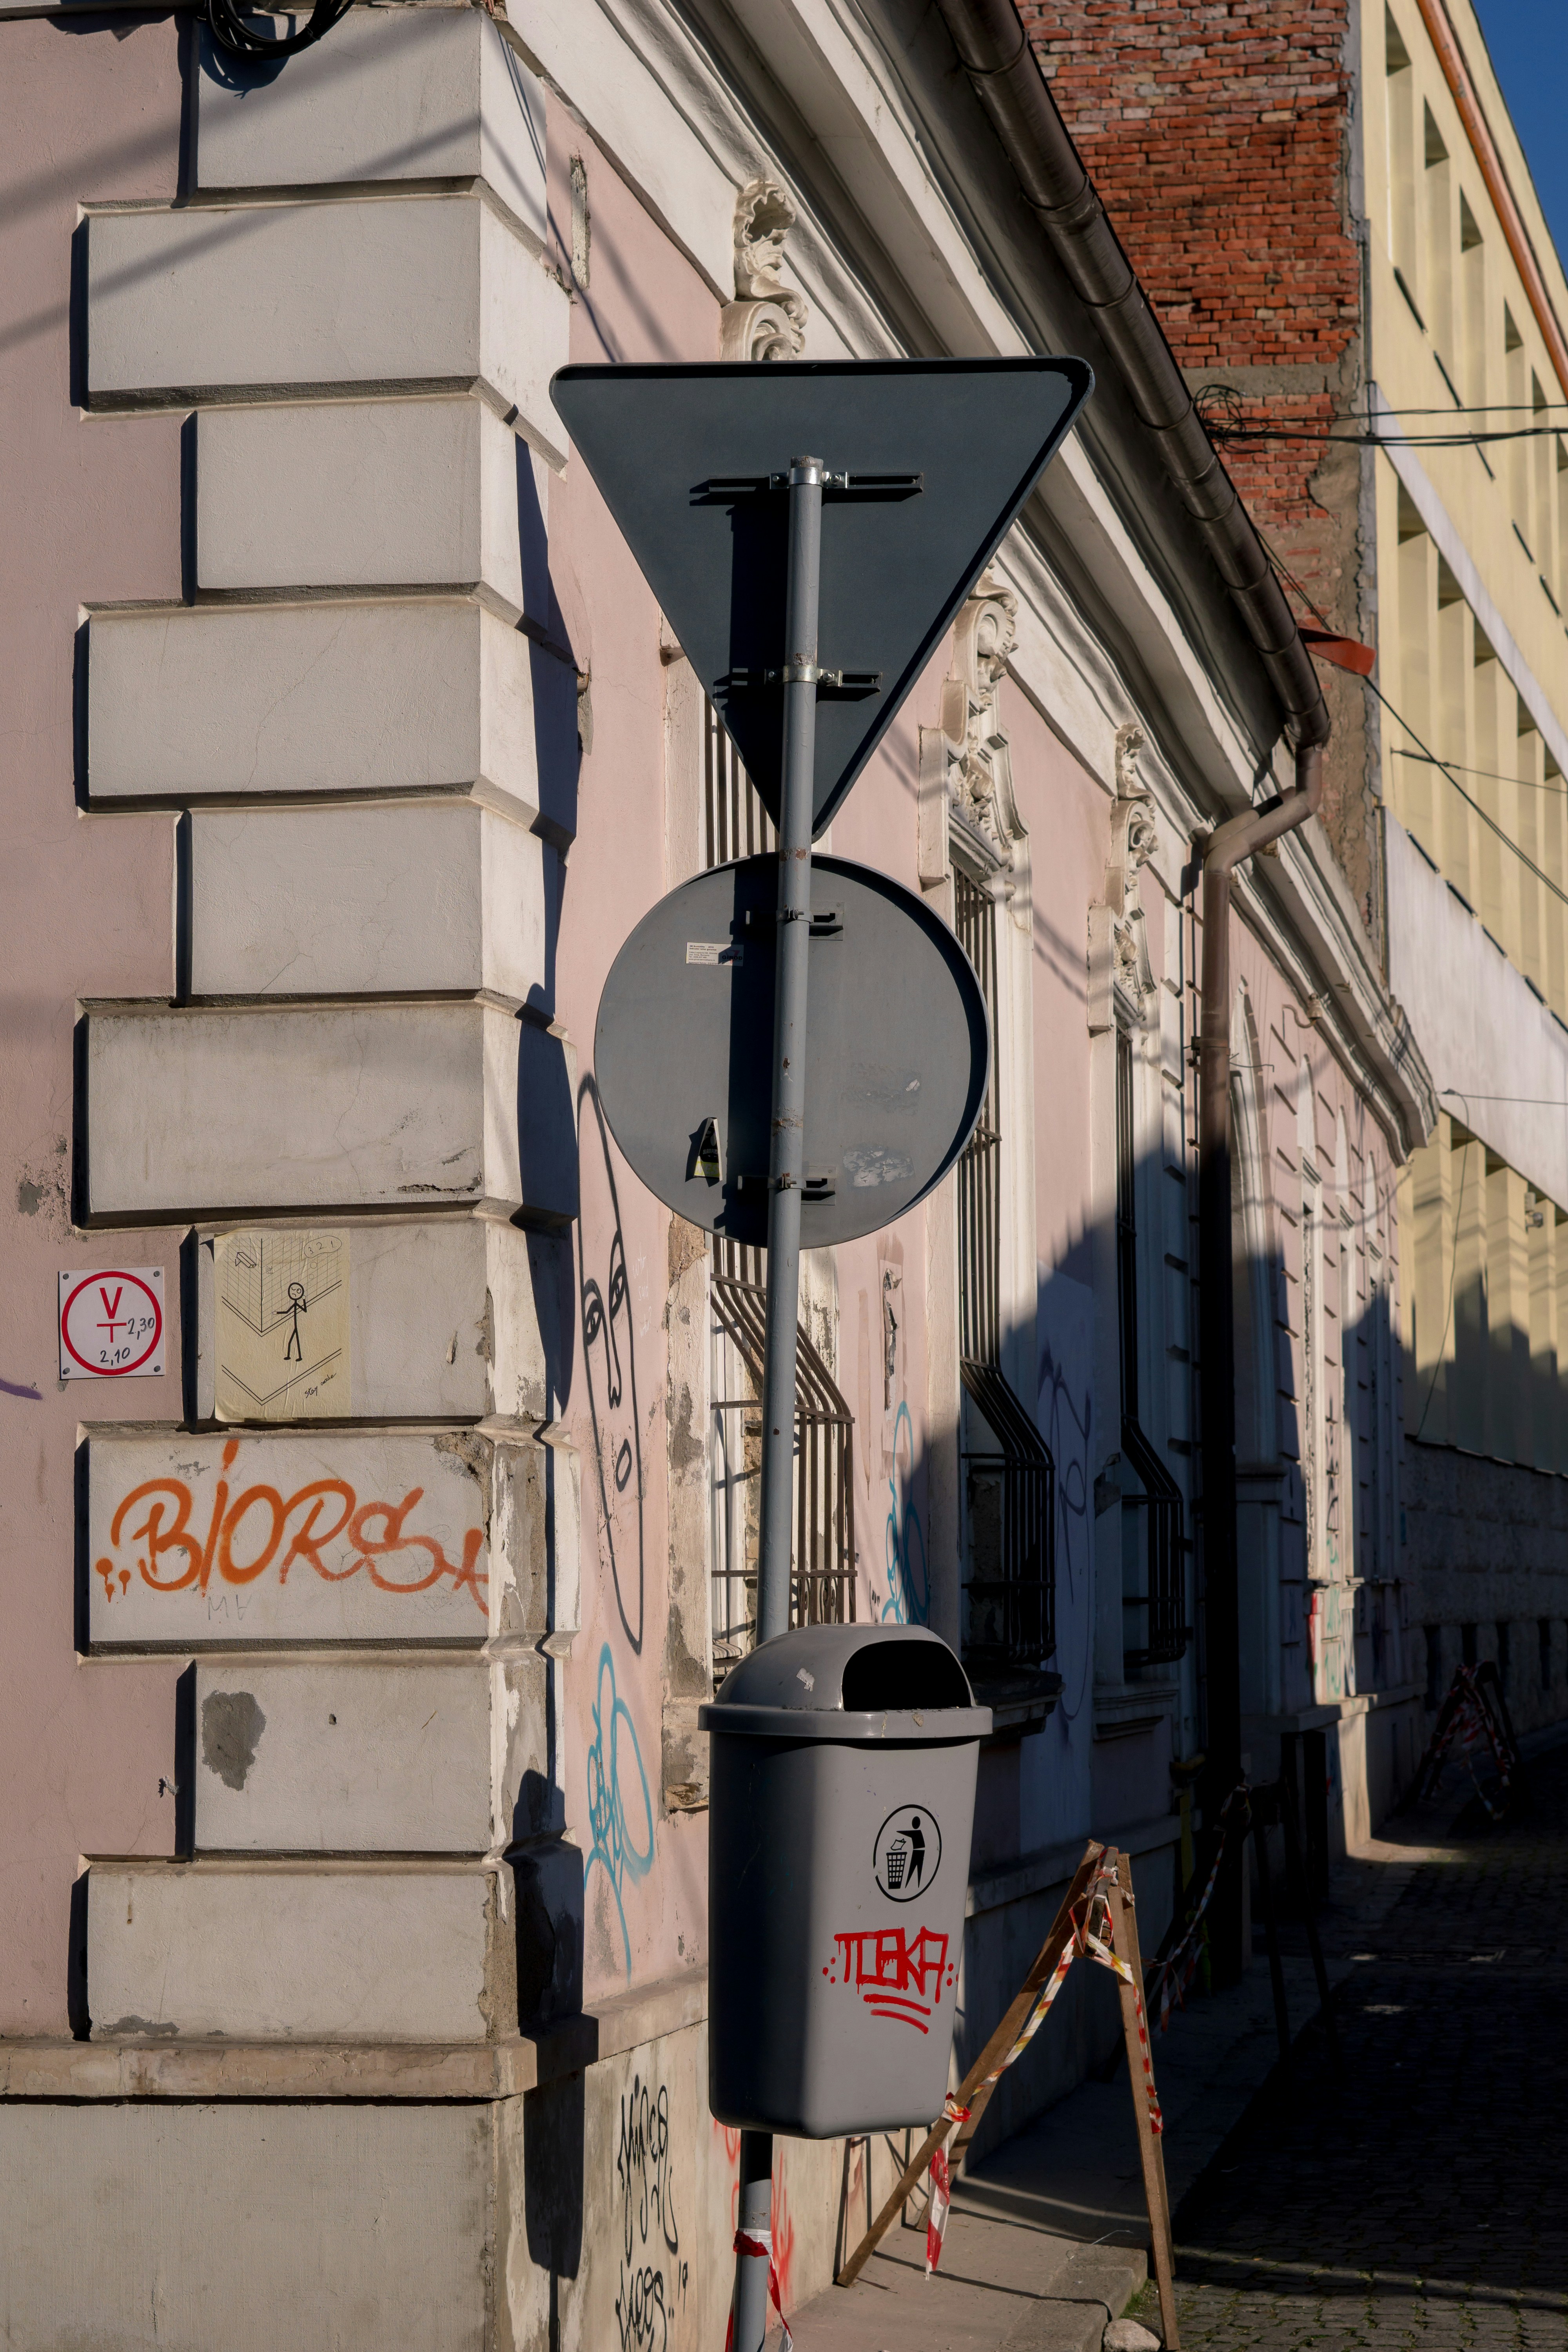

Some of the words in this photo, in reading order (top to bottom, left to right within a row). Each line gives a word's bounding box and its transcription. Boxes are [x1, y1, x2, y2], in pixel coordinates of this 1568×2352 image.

[638, 1270, 649, 1301] said
[99, 1287, 123, 1319] V
[127, 1317, 155, 1340] 2,30
[100, 1347, 131, 1366] 2,10
[320, 1373, 337, 1386] awake
